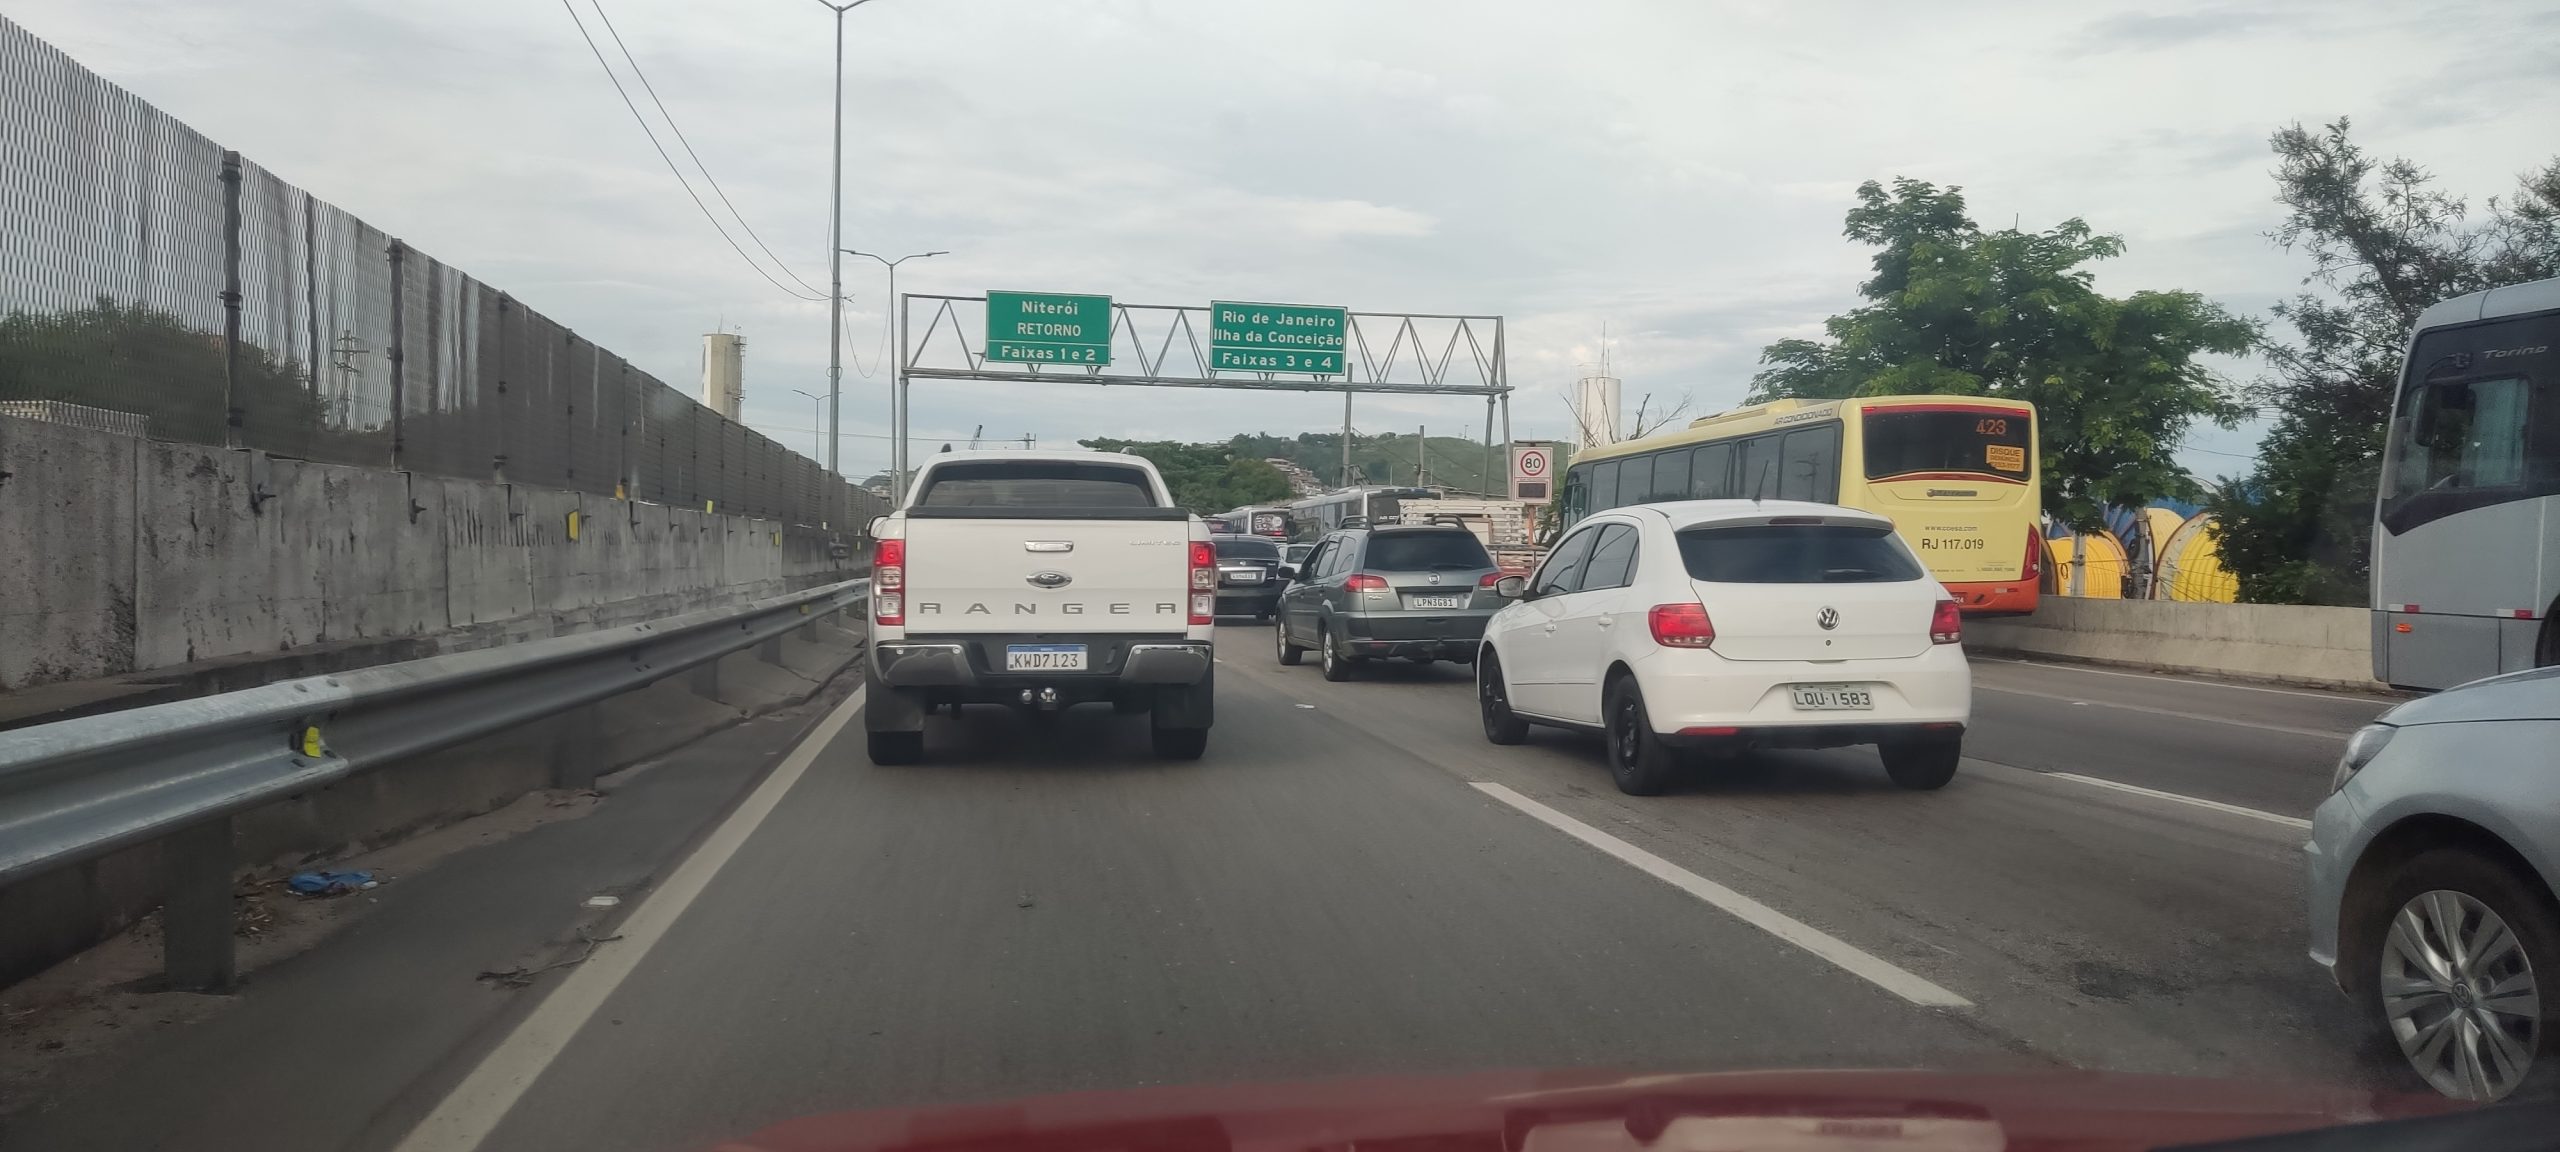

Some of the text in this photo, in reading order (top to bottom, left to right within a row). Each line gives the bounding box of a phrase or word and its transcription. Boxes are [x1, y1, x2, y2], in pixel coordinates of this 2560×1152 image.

[1022, 301, 1079, 315] Niterói
[1222, 310, 1335, 327] Rio de Janeiro
[1017, 322, 1081, 337] RETORNO
[1214, 328, 1343, 347] Ilha da Conceição
[1001, 345, 1096, 361] Faixas 1 e 2
[1222, 352, 1333, 368] Faixas 3 e 4
[2483, 346, 2548, 359] Torino
[1976, 418, 2006, 435] 423
[1990, 447, 2021, 457] DISQUE
[1525, 457, 1541, 469] 80
[1921, 538, 1984, 550] RJ 117.019
[919, 603, 1177, 615] RANGER
[1014, 653, 1079, 668] KWD7I23
